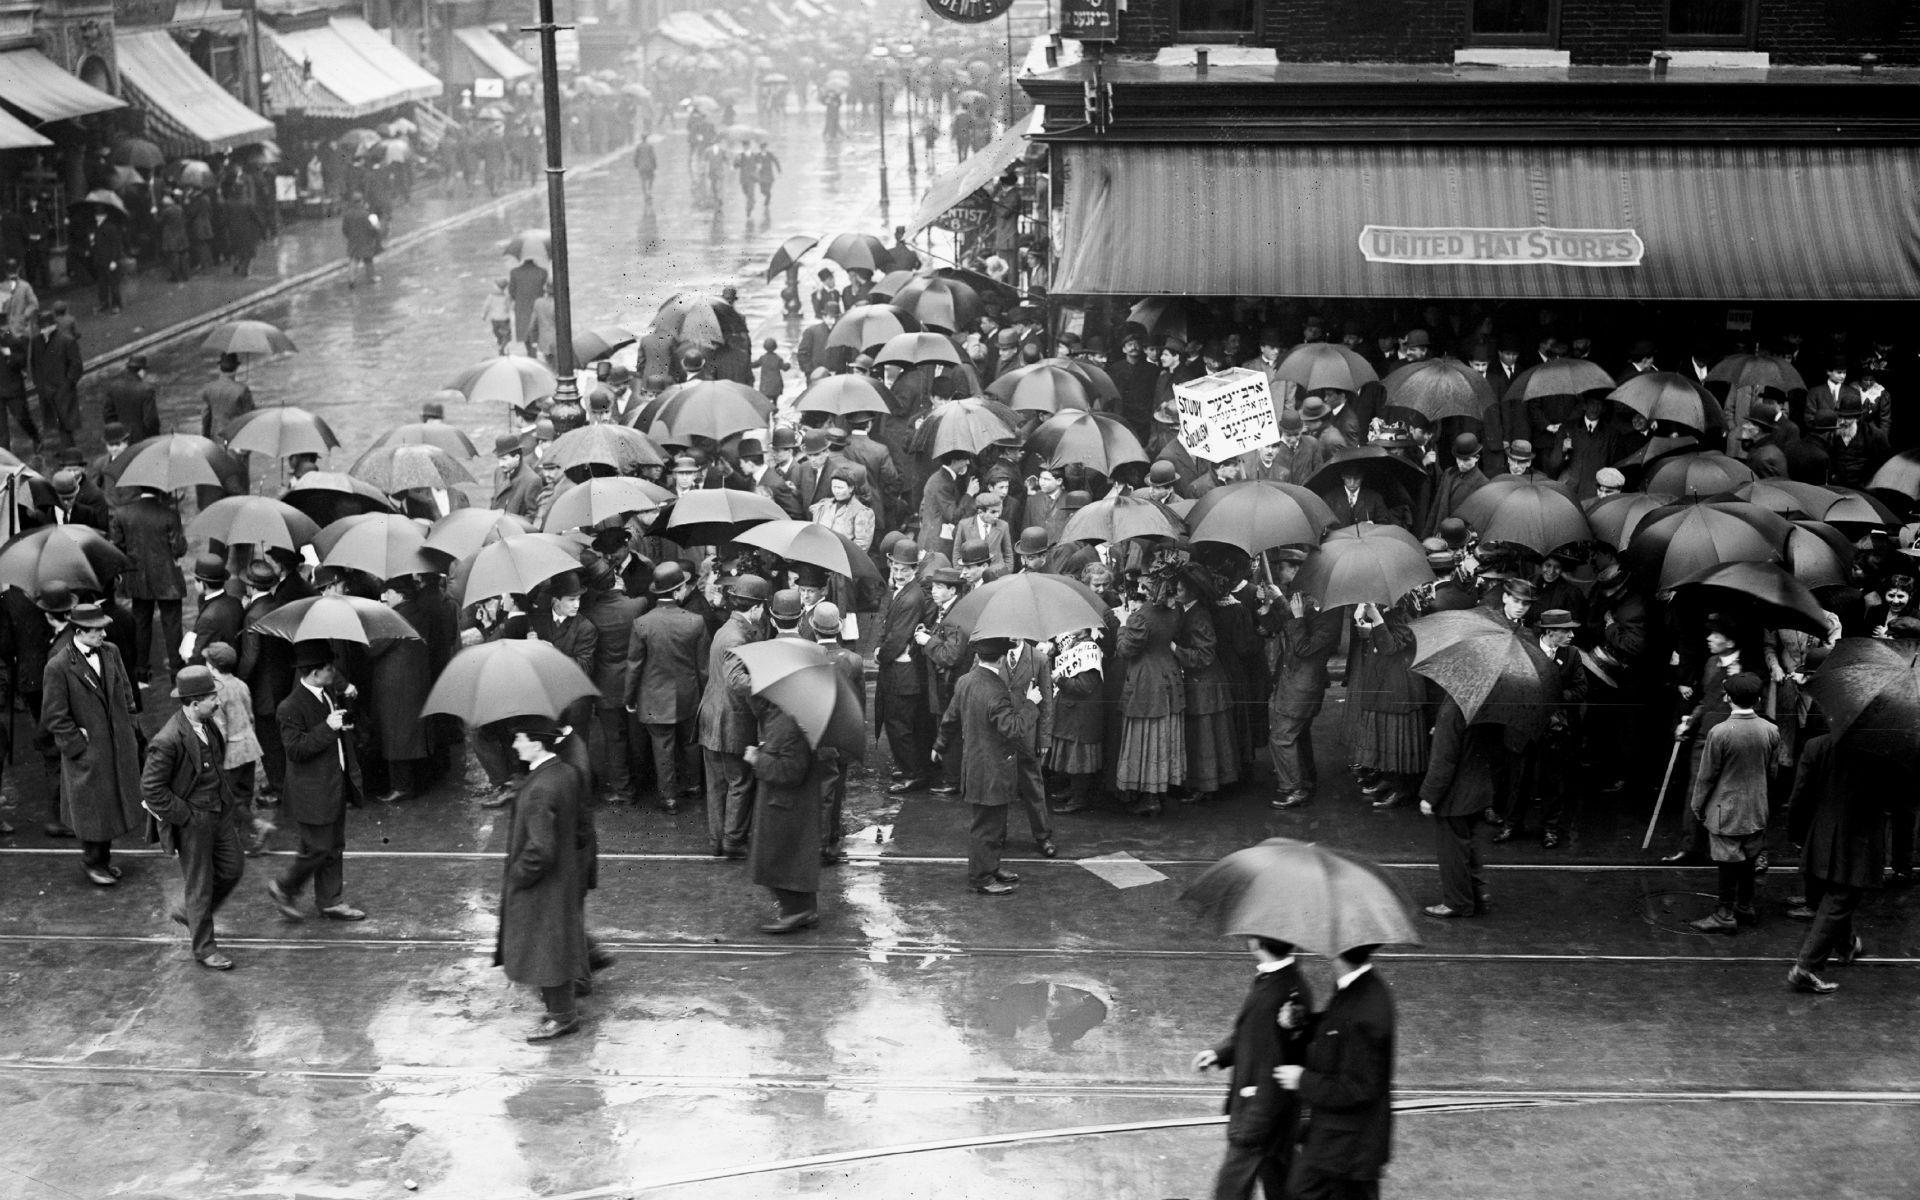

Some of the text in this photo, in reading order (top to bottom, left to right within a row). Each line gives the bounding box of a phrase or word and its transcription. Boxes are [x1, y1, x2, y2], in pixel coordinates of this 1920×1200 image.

[1372, 230, 1634, 260] UNITED HAT STORES
[1178, 395, 1202, 418] STUDY
